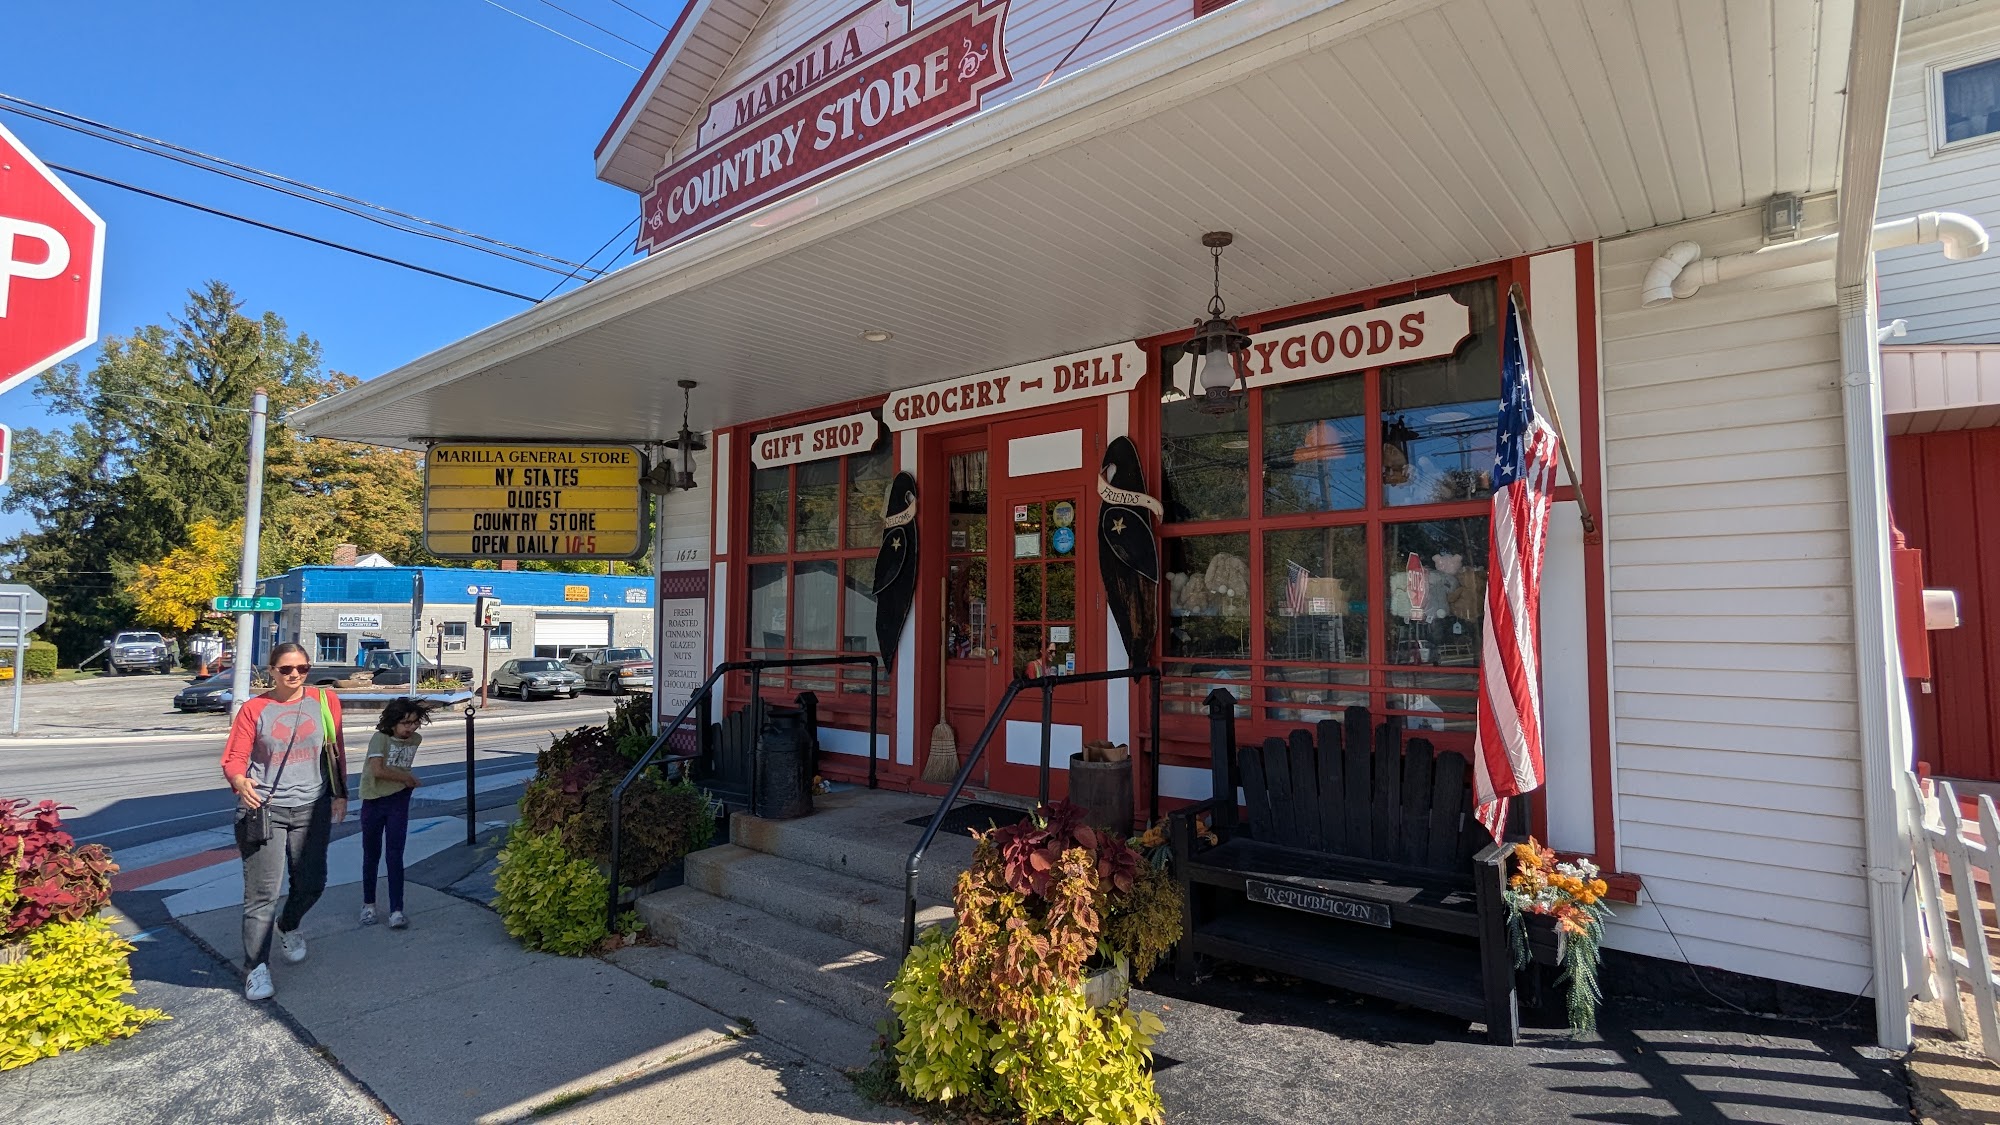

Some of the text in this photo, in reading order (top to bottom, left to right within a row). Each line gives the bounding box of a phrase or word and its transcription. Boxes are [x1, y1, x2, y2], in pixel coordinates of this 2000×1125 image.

[733, 28, 863, 127] MARILLA
[666, 46, 950, 224] COUNTRY STORE
[1230, 310, 1425, 379] RYGOODS
[894, 376, 1011, 422] GROCERY
[1053, 353, 1123, 394] DELI
[761, 421, 864, 461] GIFT SHOP
[436, 450, 630, 464] MARILLA GENERAL STORE
[495, 468, 579, 487] NY STATES
[507, 490, 562, 509] OLDEST
[1101, 486, 1140, 504] FRIENDS
[473, 512, 596, 531] COUNTRY STORE
[472, 535, 596, 554] OPEN DAILY 10-5
[676, 549, 698, 561] 1673
[673, 608, 694, 617] FRESH
[668, 619, 699, 628] ROASTED
[665, 630, 702, 638] CINNAMON
[670, 641, 697, 649] GLAZED
[673, 651, 692, 660] NUTS
[667, 669, 698, 679] SPECIALTY
[663, 680, 702, 690] CHOCOLATES
[671, 698, 691, 707] CAND
[1264, 886, 1371, 920] REPUBLICAN
